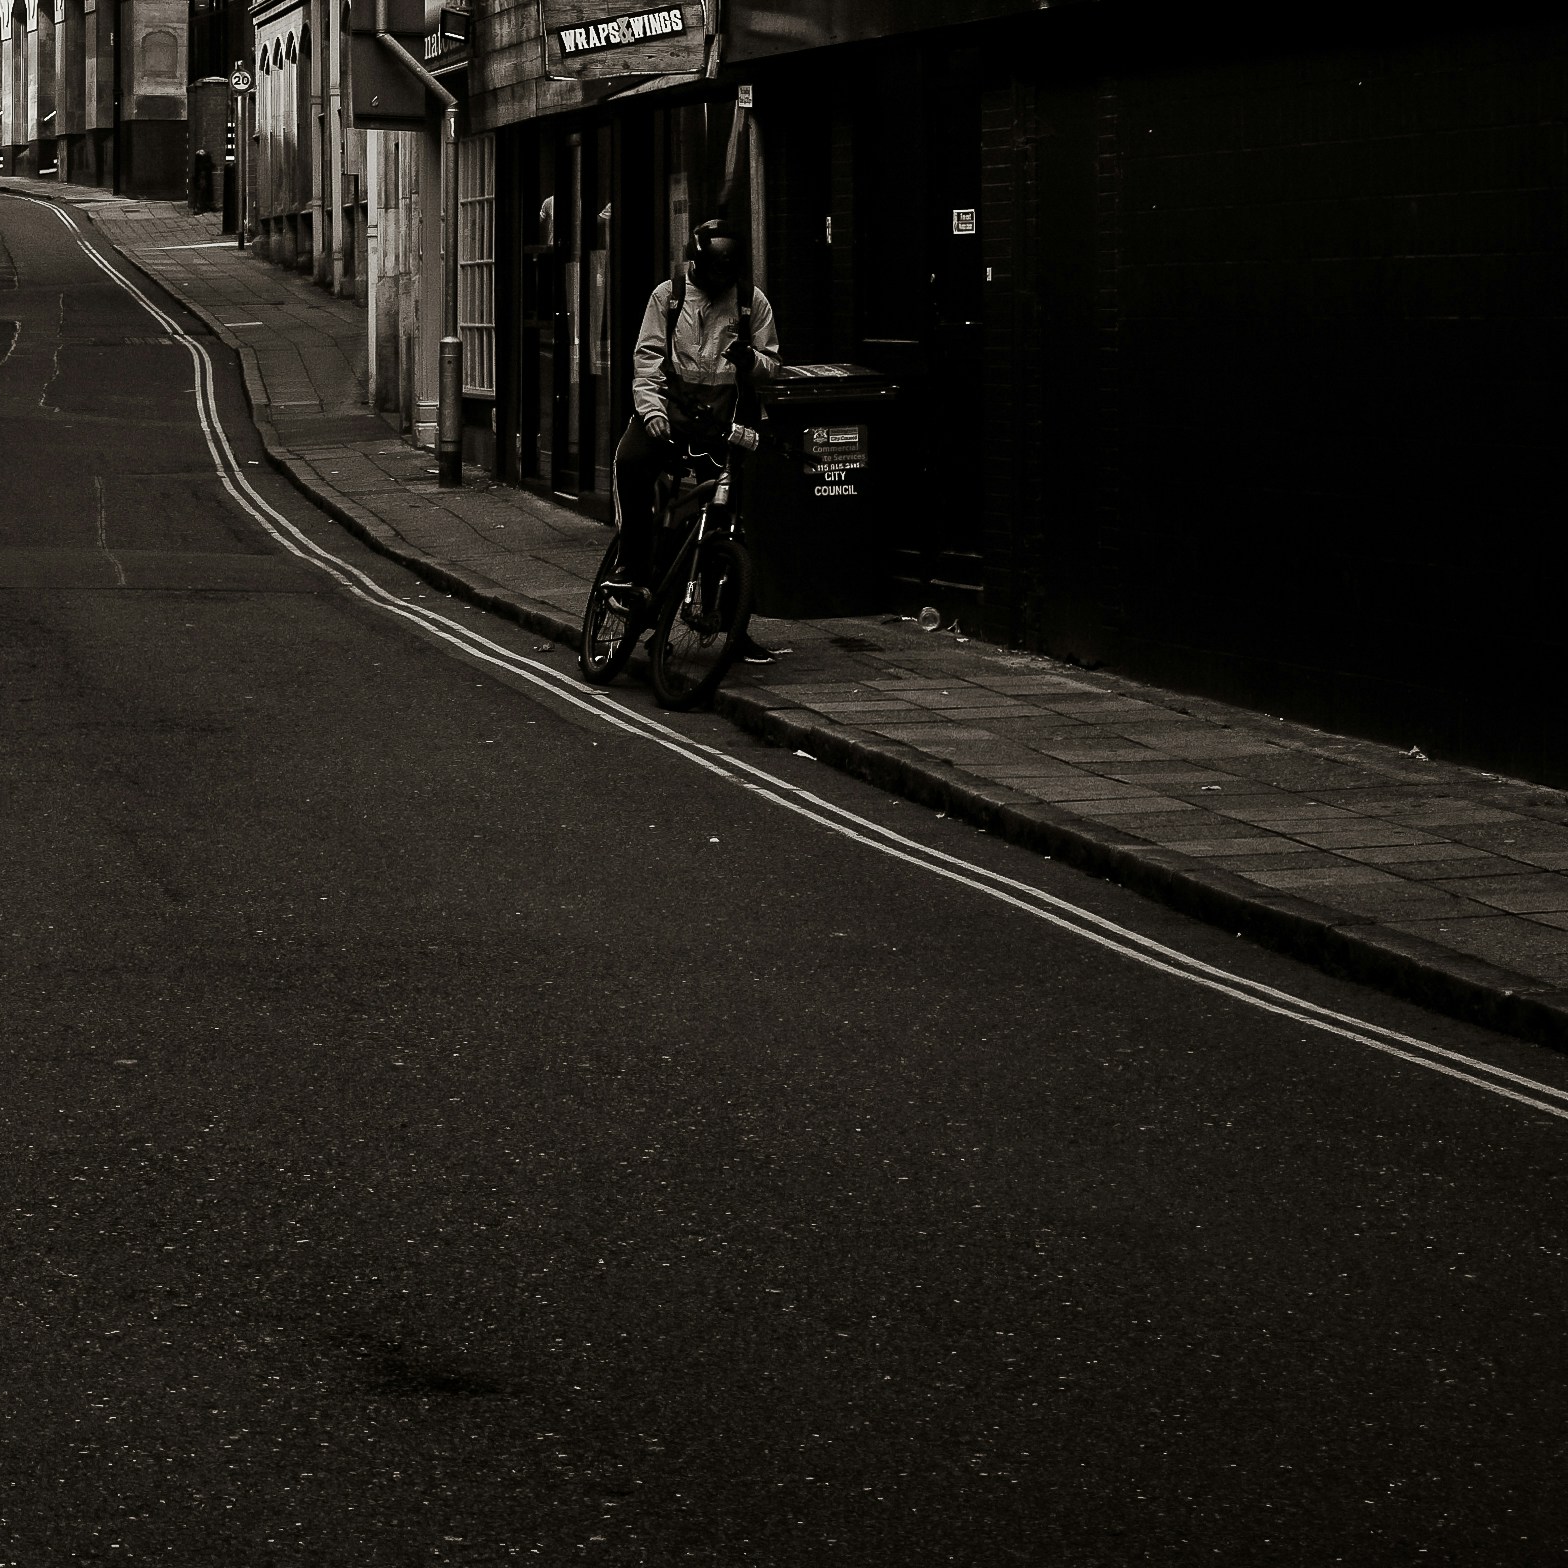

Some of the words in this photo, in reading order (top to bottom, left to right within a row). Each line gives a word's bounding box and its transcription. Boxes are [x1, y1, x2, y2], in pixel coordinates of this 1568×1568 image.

[233, 75, 250, 86] 20
[812, 445, 858, 453] Commercial
[833, 453, 866, 462] Services
[824, 470, 847, 481] CITY
[814, 484, 858, 496] COUNCIL
